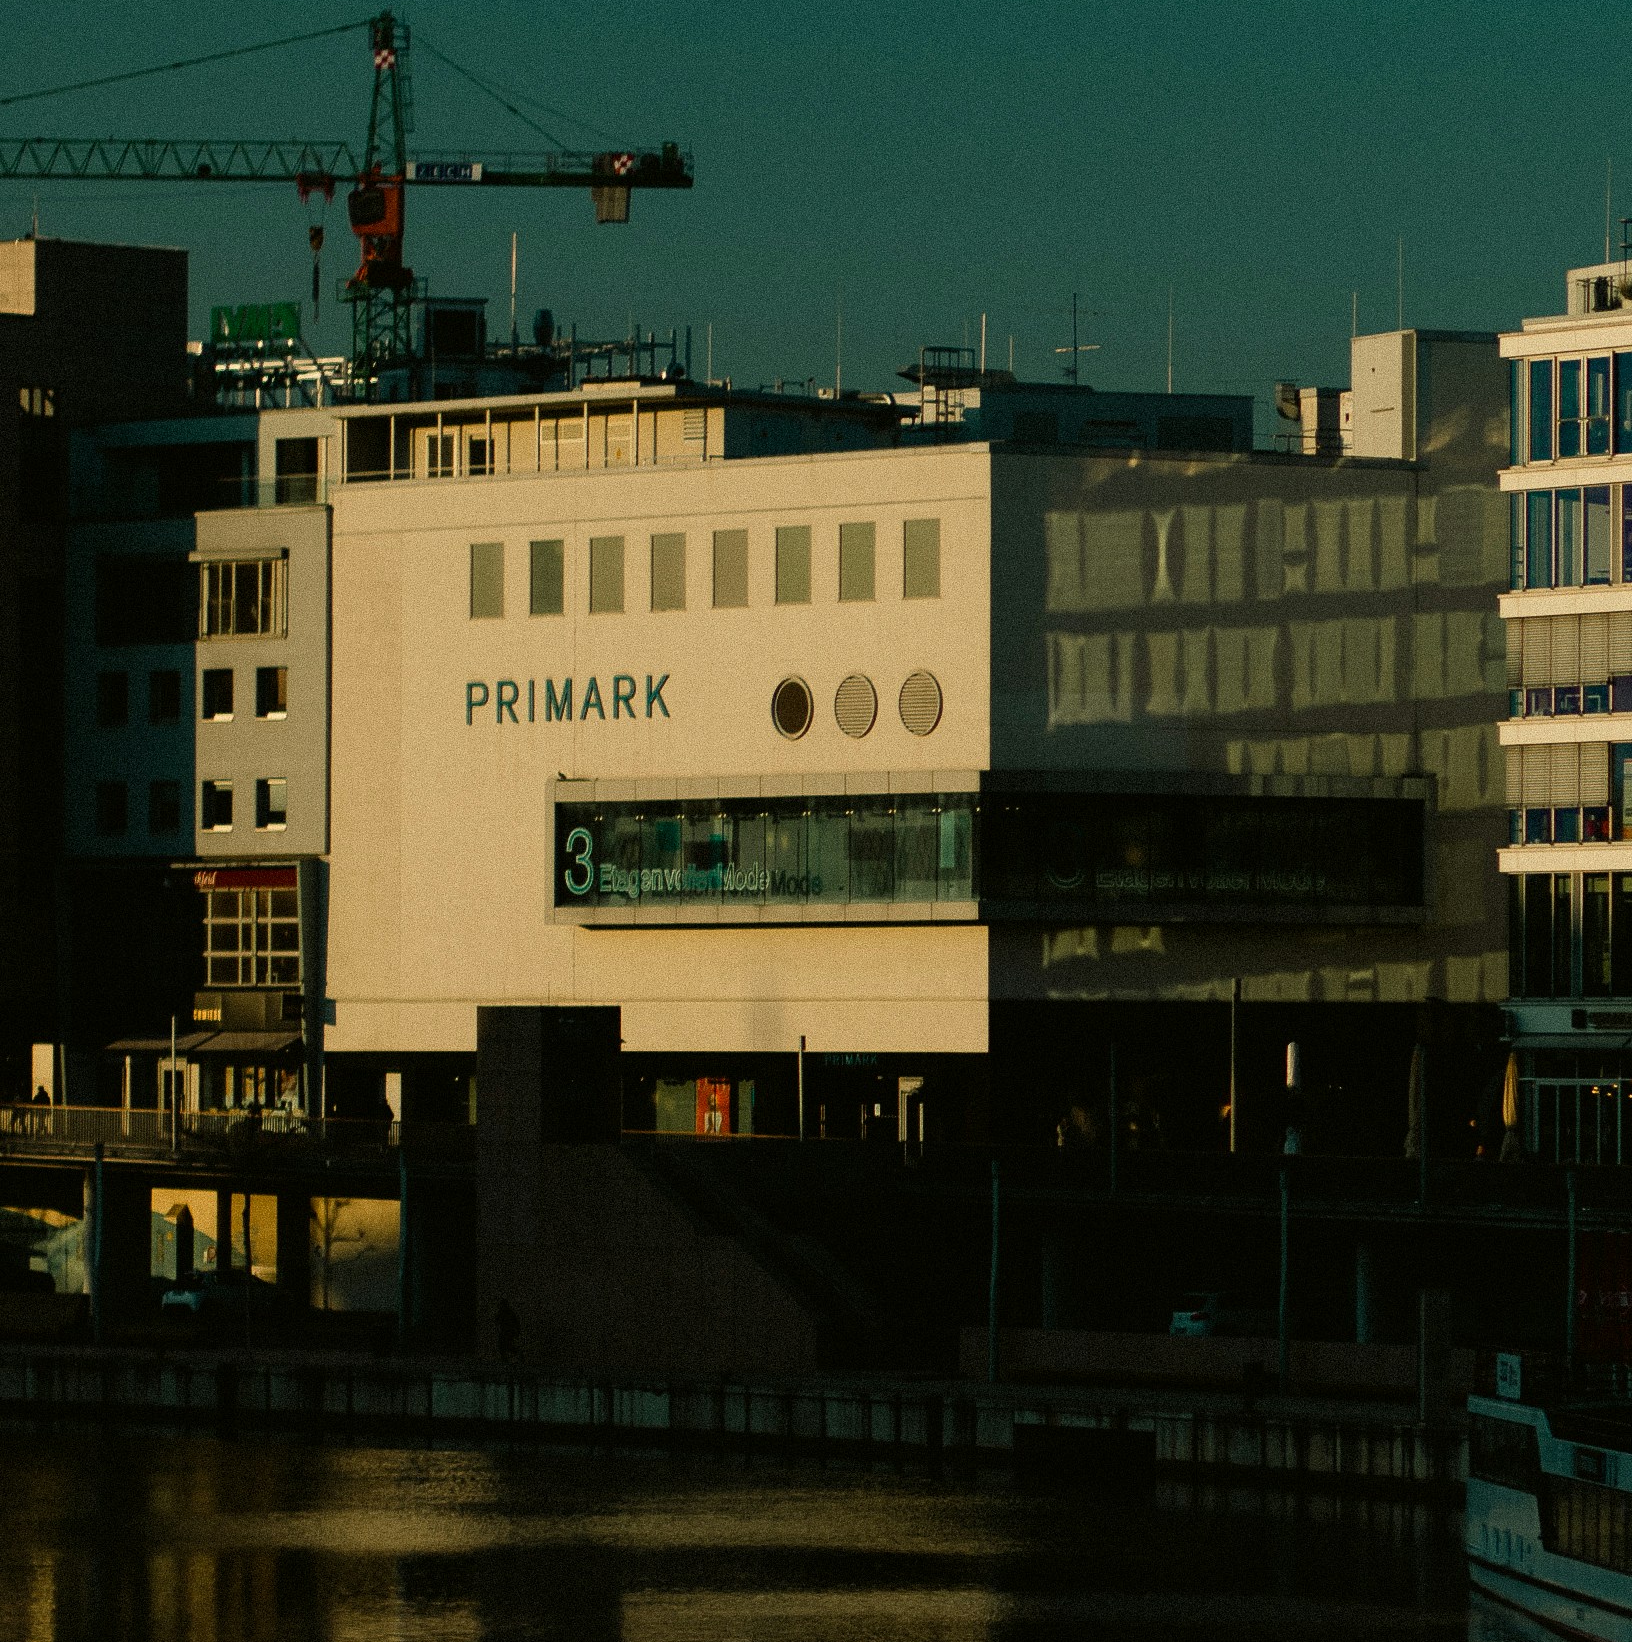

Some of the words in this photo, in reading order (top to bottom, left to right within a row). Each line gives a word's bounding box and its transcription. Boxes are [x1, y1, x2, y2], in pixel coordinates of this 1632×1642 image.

[466, 674, 670, 726] PRIMARK
[564, 826, 595, 895] 3
[824, 1053, 878, 1066] PRIMARK
